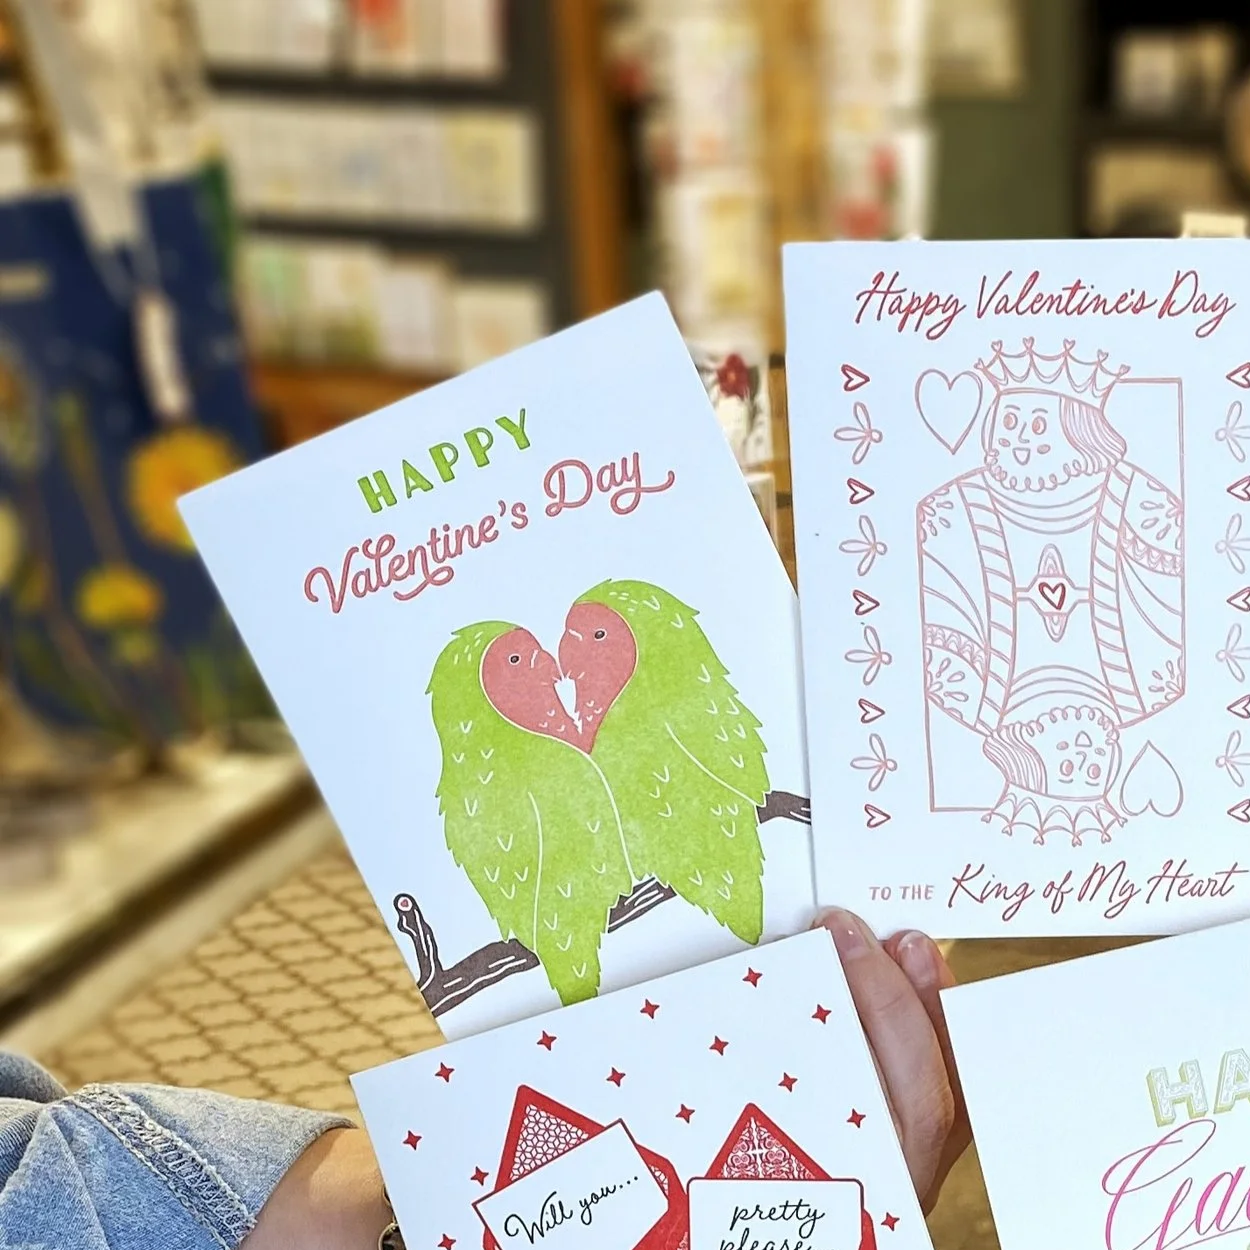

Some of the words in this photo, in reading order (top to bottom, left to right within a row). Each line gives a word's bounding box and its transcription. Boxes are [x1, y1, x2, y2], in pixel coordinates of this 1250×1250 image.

[854, 270, 967, 339] Happy
[975, 269, 1159, 320] Valentine's
[1158, 270, 1237, 339] Day
[357, 408, 531, 513] HAPPY
[304, 500, 528, 613] Valentine's
[543, 452, 675, 517] Day
[869, 884, 893, 901] TO
[900, 883, 935, 901] THE
[948, 862, 1035, 921] King
[1042, 870, 1074, 918] of
[1078, 861, 1141, 918] My
[1146, 860, 1249, 905] Heart
[503, 1191, 575, 1244] Will
[579, 1174, 639, 1228] you...
[730, 1199, 826, 1238] pretty
